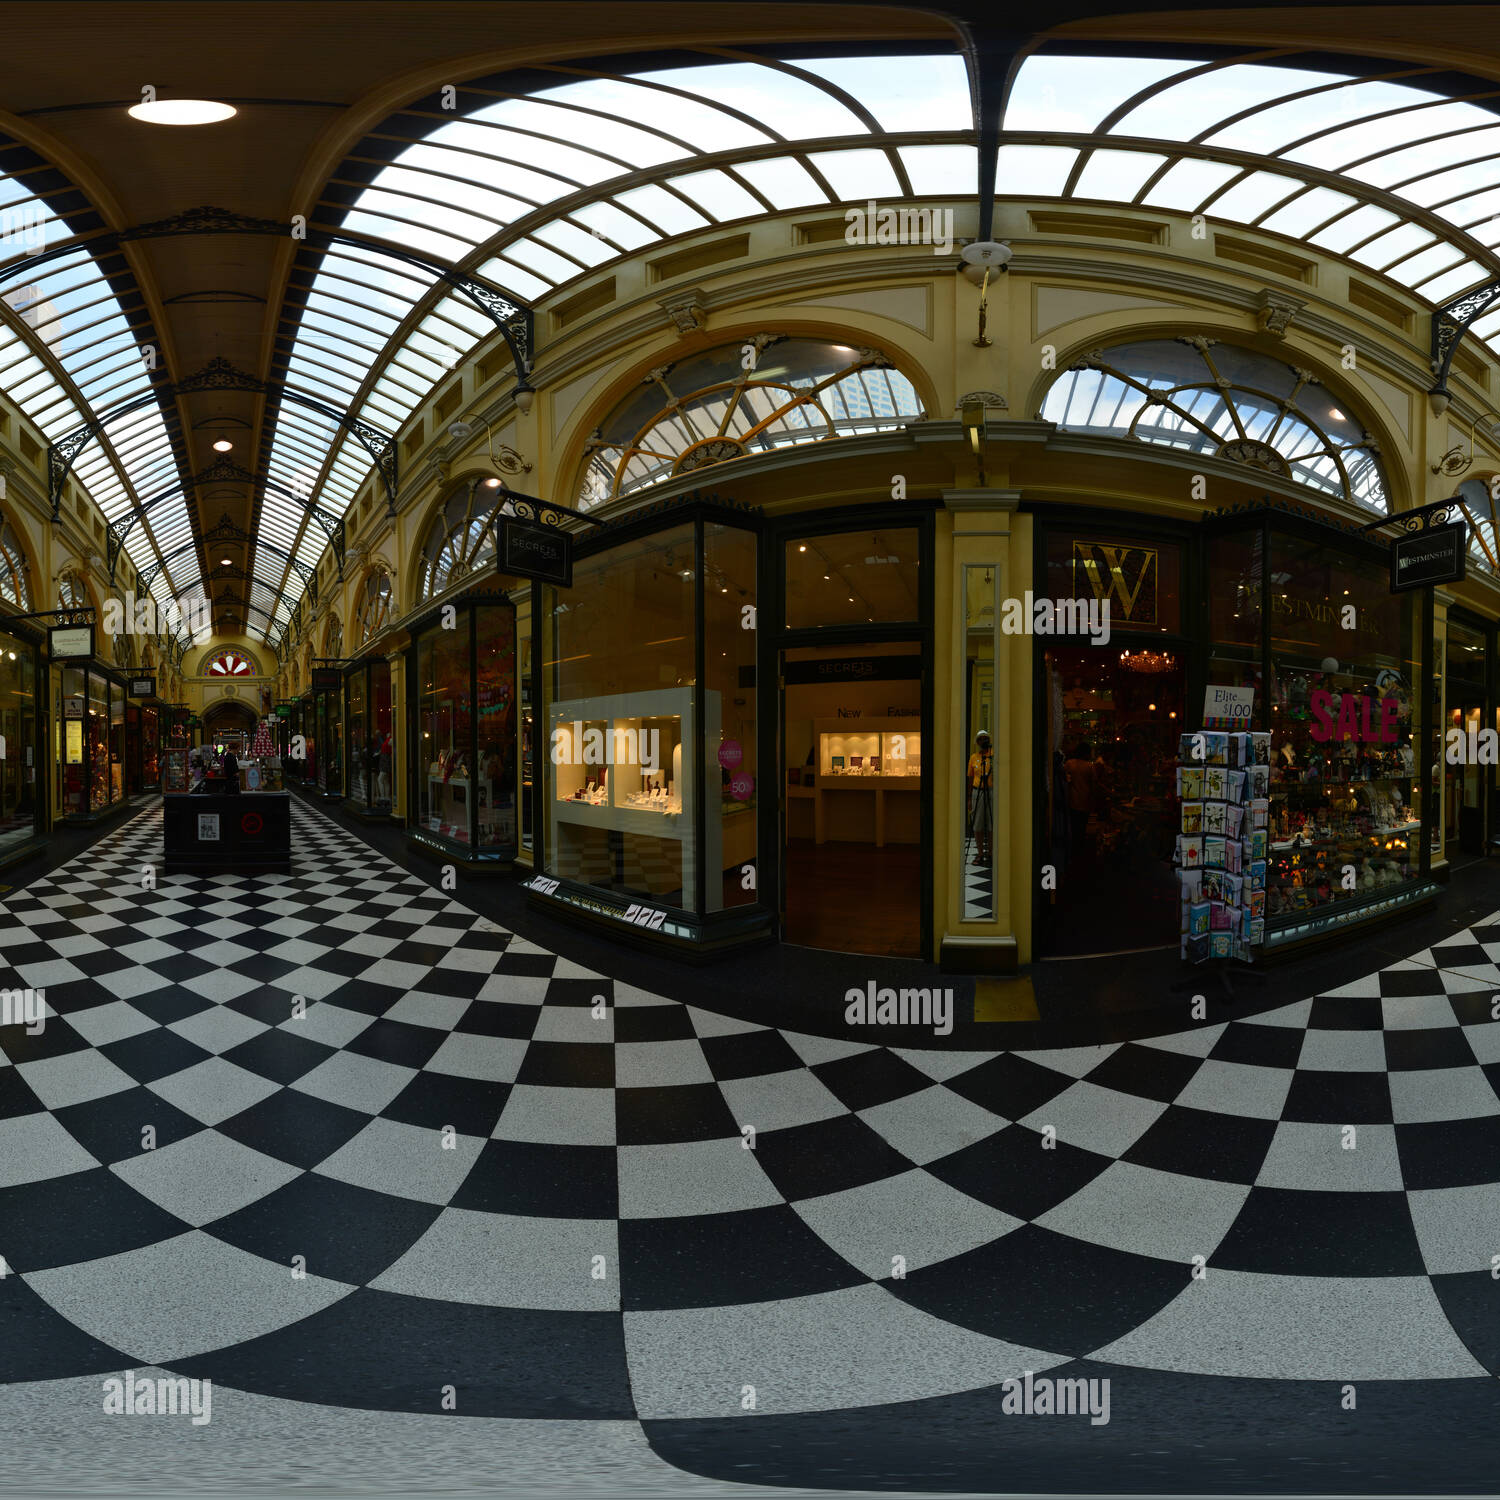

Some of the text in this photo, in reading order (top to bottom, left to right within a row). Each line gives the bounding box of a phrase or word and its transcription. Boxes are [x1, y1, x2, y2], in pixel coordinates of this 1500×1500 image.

[1399, 548, 1453, 570] WESTMINSTER
[1076, 542, 1153, 620] W
[1215, 689, 1238, 702] Elite
[1223, 703, 1251, 717] $1.00
[1311, 689, 1398, 743] SALE
